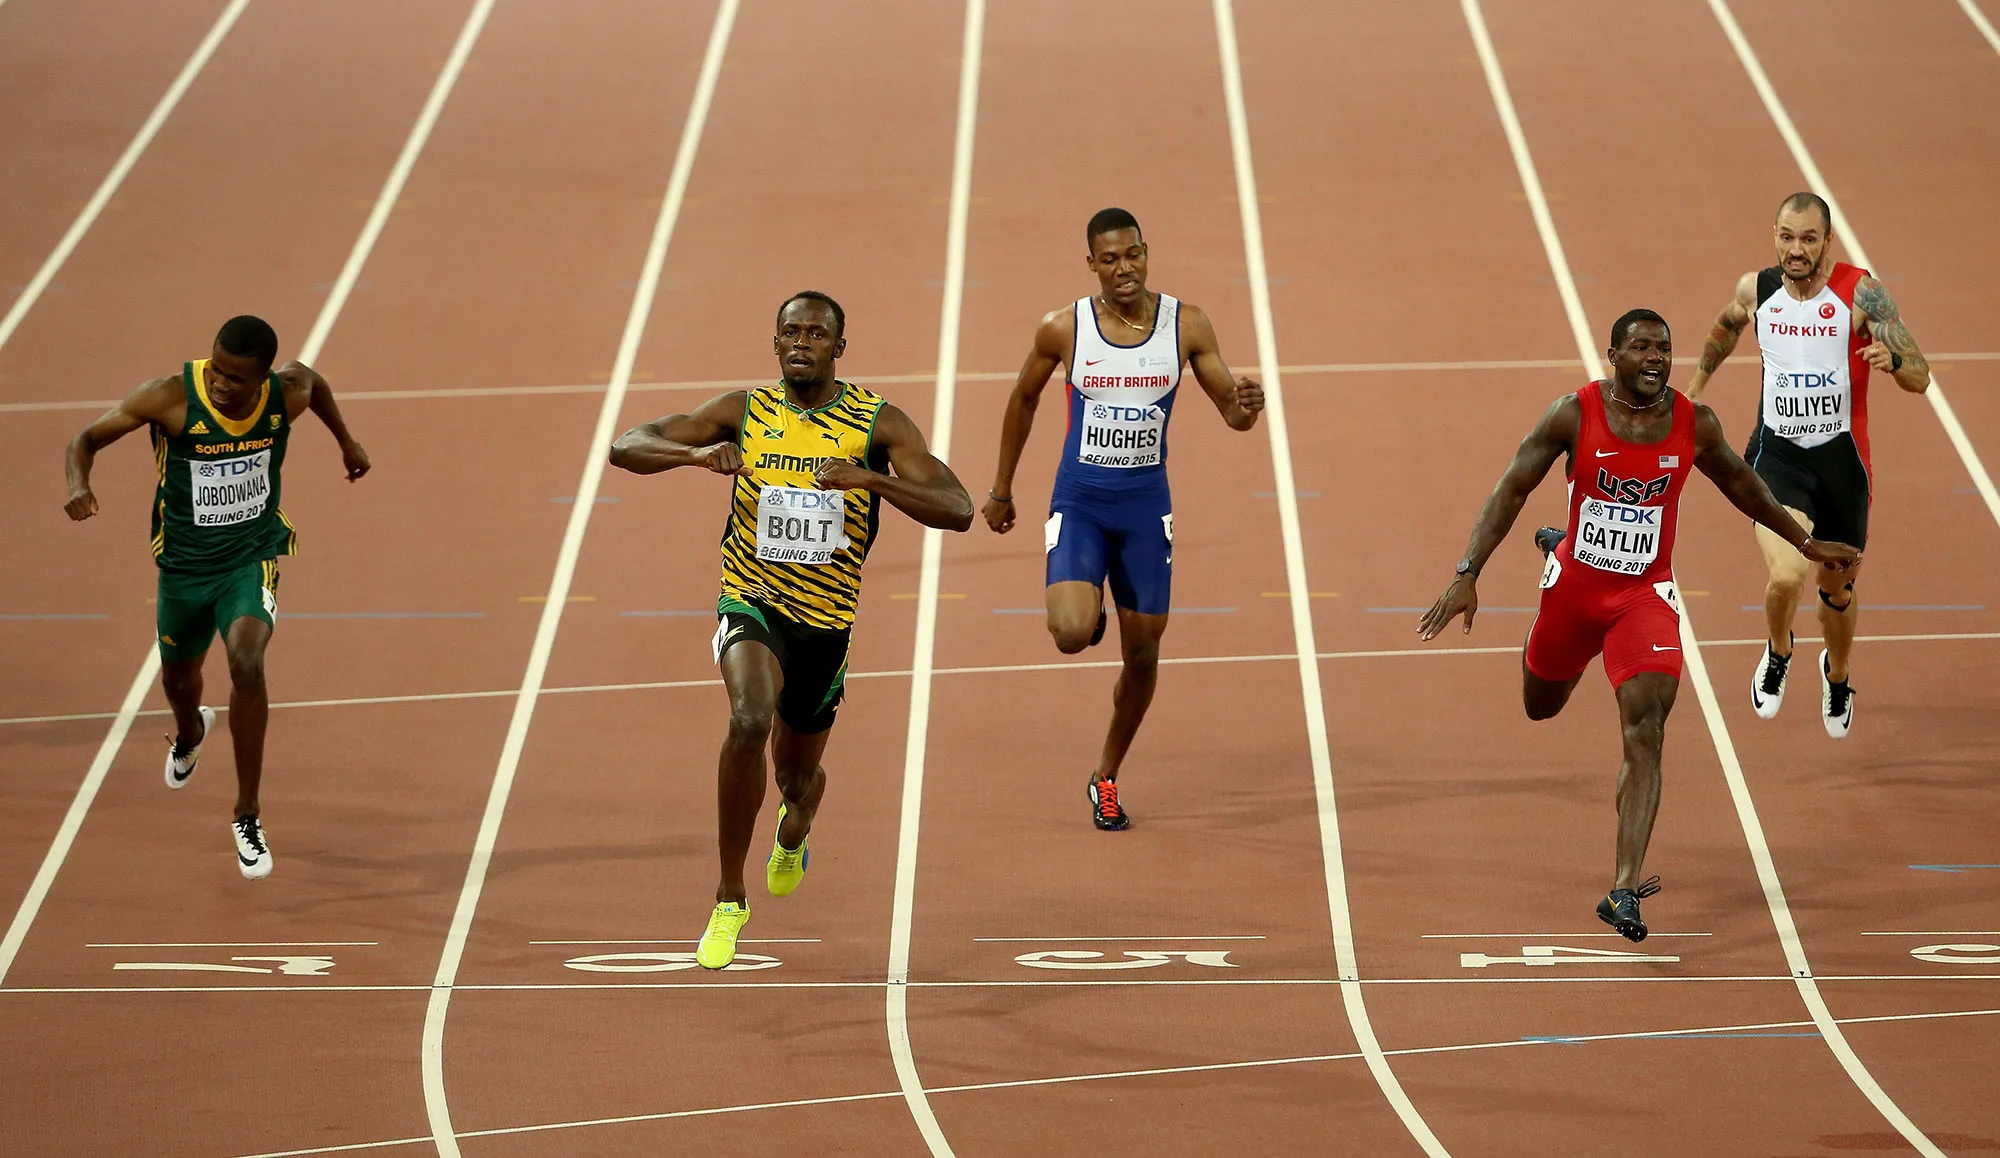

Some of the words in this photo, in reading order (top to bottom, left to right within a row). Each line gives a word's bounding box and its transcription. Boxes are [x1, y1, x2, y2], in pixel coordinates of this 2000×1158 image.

[1770, 322, 1838, 337] TÜRKİYE
[1083, 375, 1121, 388] GREAT
[1124, 375, 1169, 388] BRITAIN
[1788, 371, 1838, 388] TDK
[1108, 405, 1158, 422] TDK
[1775, 393, 1842, 417] GULIYEV
[1086, 425, 1158, 449] HUGHES
[1778, 424, 1816, 436] BEIJING
[1819, 419, 1842, 433] 2015
[195, 442, 234, 455] SOUTH
[237, 437, 274, 452] AFRICA
[214, 455, 263, 477] TDK
[755, 453, 848, 473] JAMAI
[1084, 453, 1130, 466] BEIJING
[1131, 453, 1156, 466] 2015
[195, 474, 268, 507] JOBODWANA
[1597, 466, 1672, 506] USA
[784, 490, 838, 510] TDK
[199, 510, 244, 524] BEIJING
[1604, 504, 1656, 525] TDK
[767, 515, 833, 543] BOLT
[1582, 521, 1655, 555] GATLIN
[760, 546, 808, 561] BEIJING
[1578, 549, 1622, 571] BEIJING
